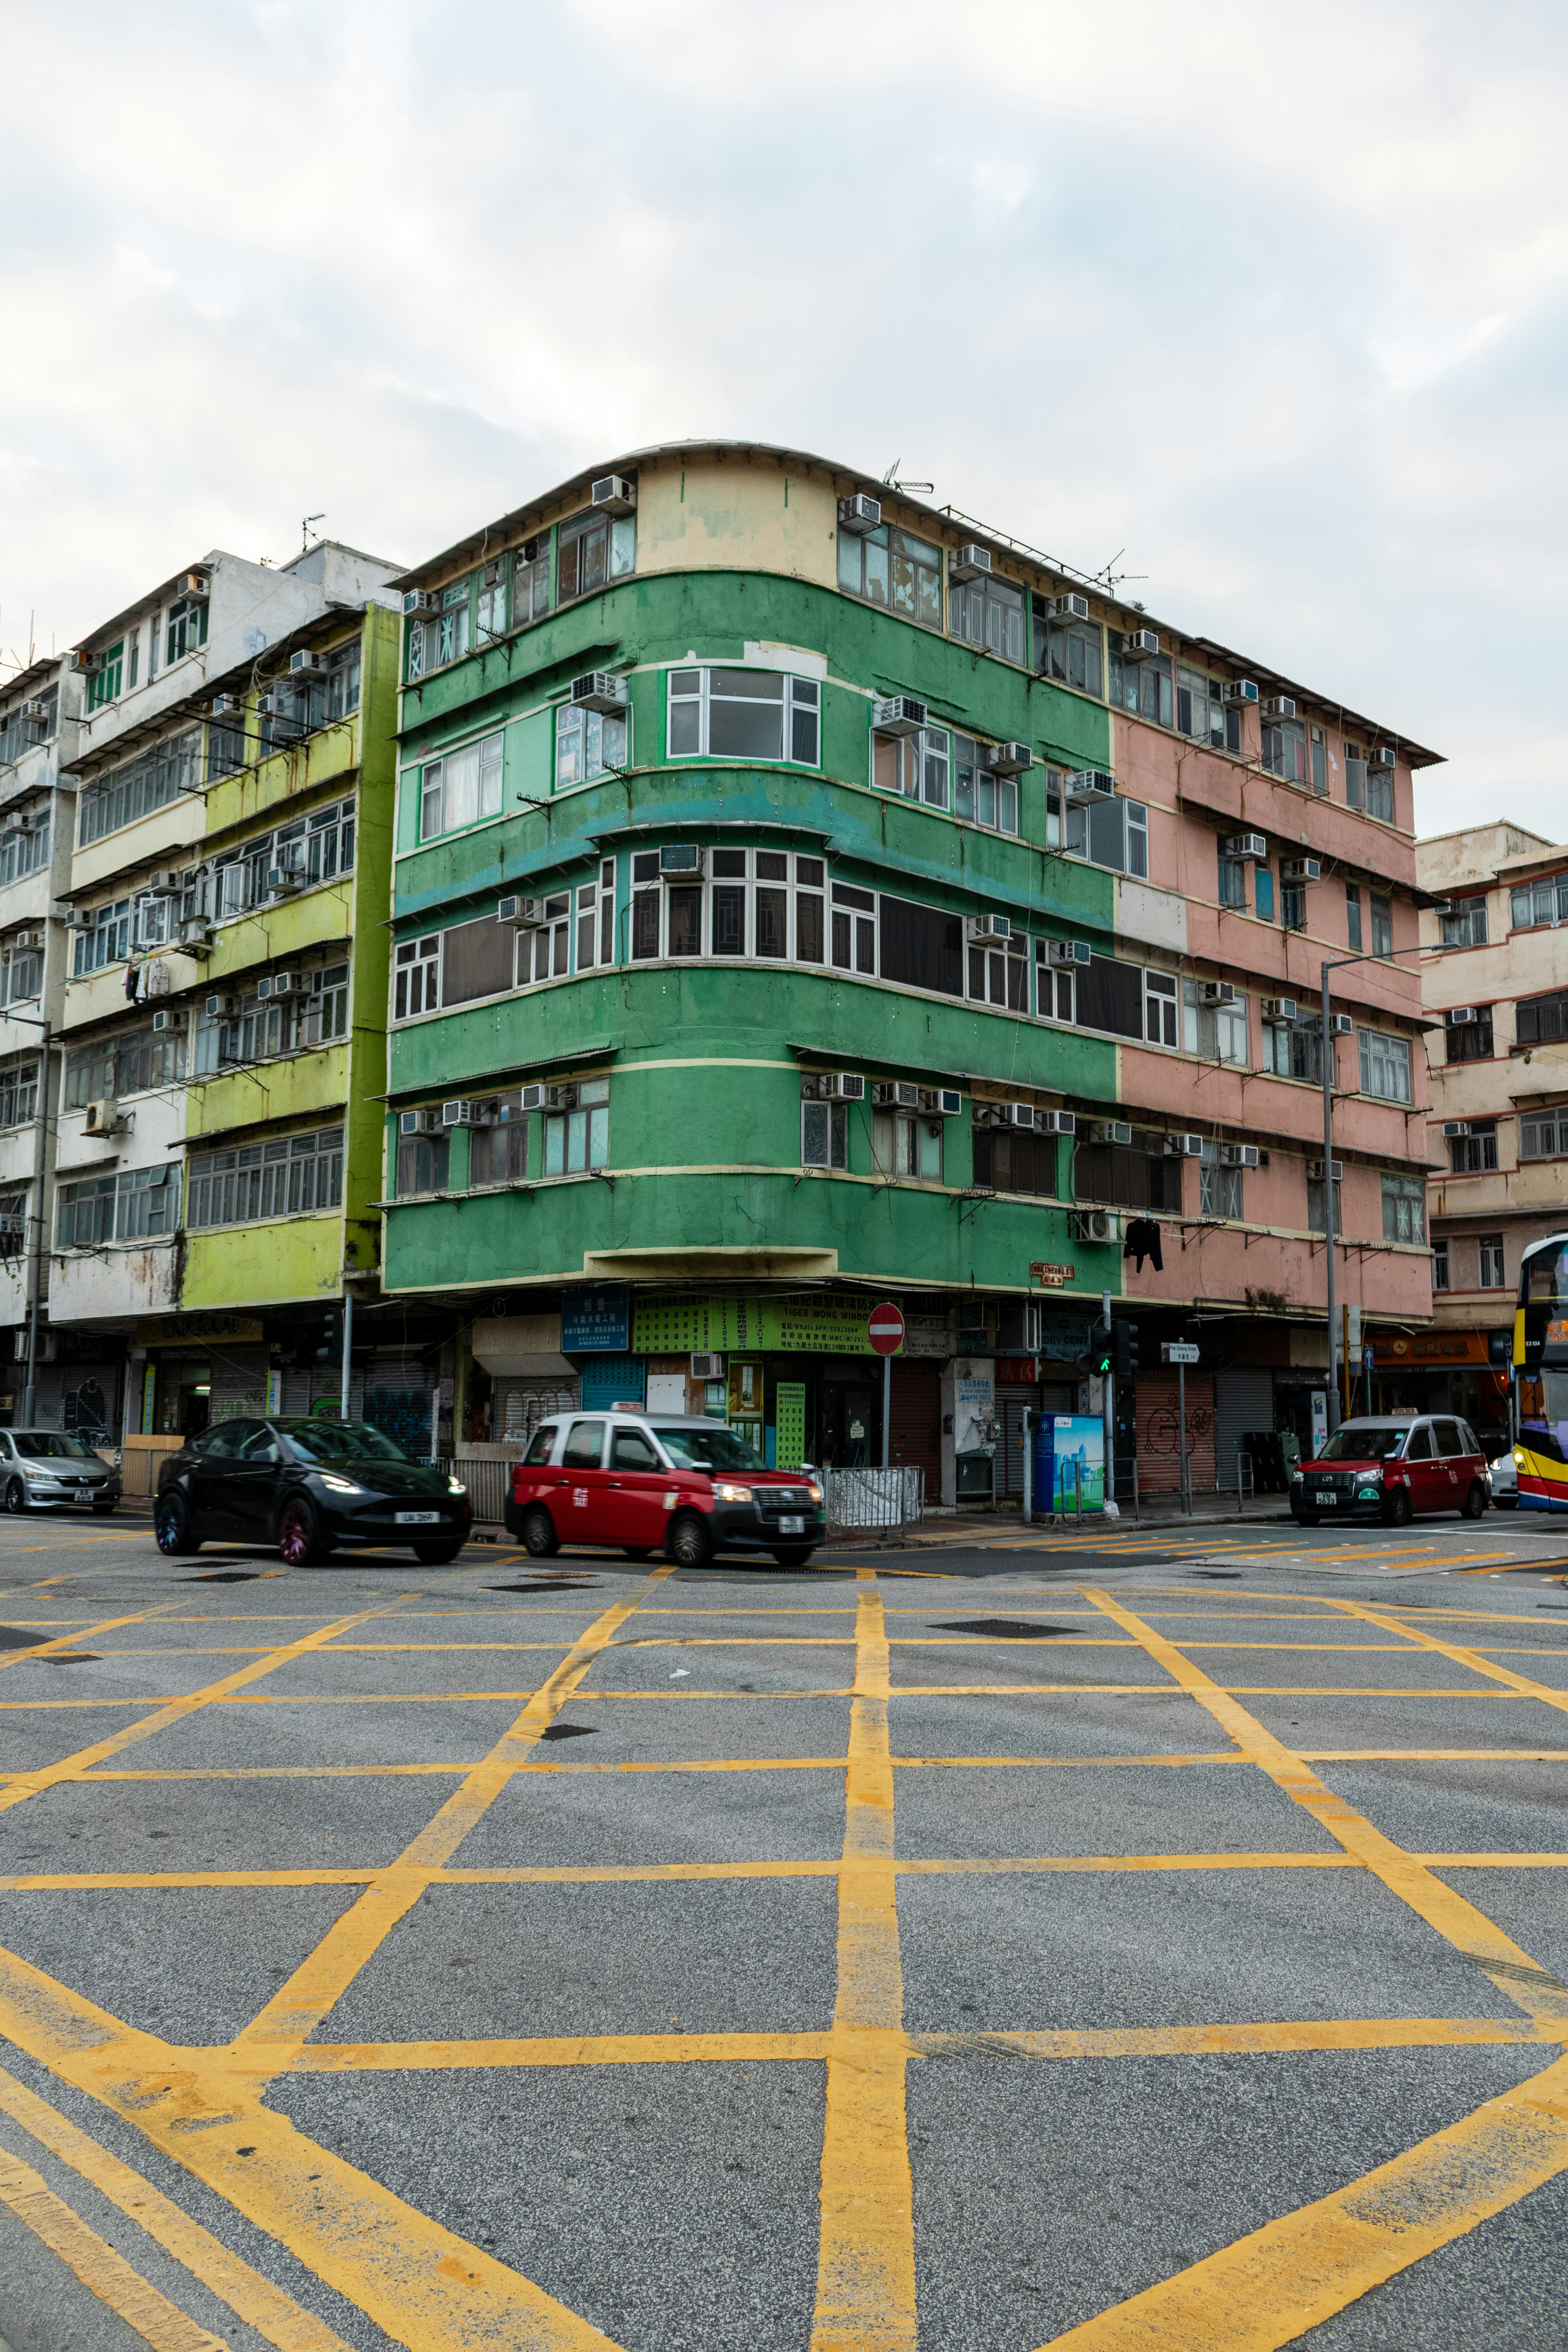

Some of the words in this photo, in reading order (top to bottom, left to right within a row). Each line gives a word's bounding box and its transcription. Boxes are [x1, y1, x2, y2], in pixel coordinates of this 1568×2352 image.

[573, 1313, 615, 1324] 冷氣水電工程
[784, 1308, 809, 1317] TIGER
[813, 1310, 838, 1319] WONG
[841, 1312, 870, 1321] WINDO
[572, 1497, 588, 1507] TAXI
